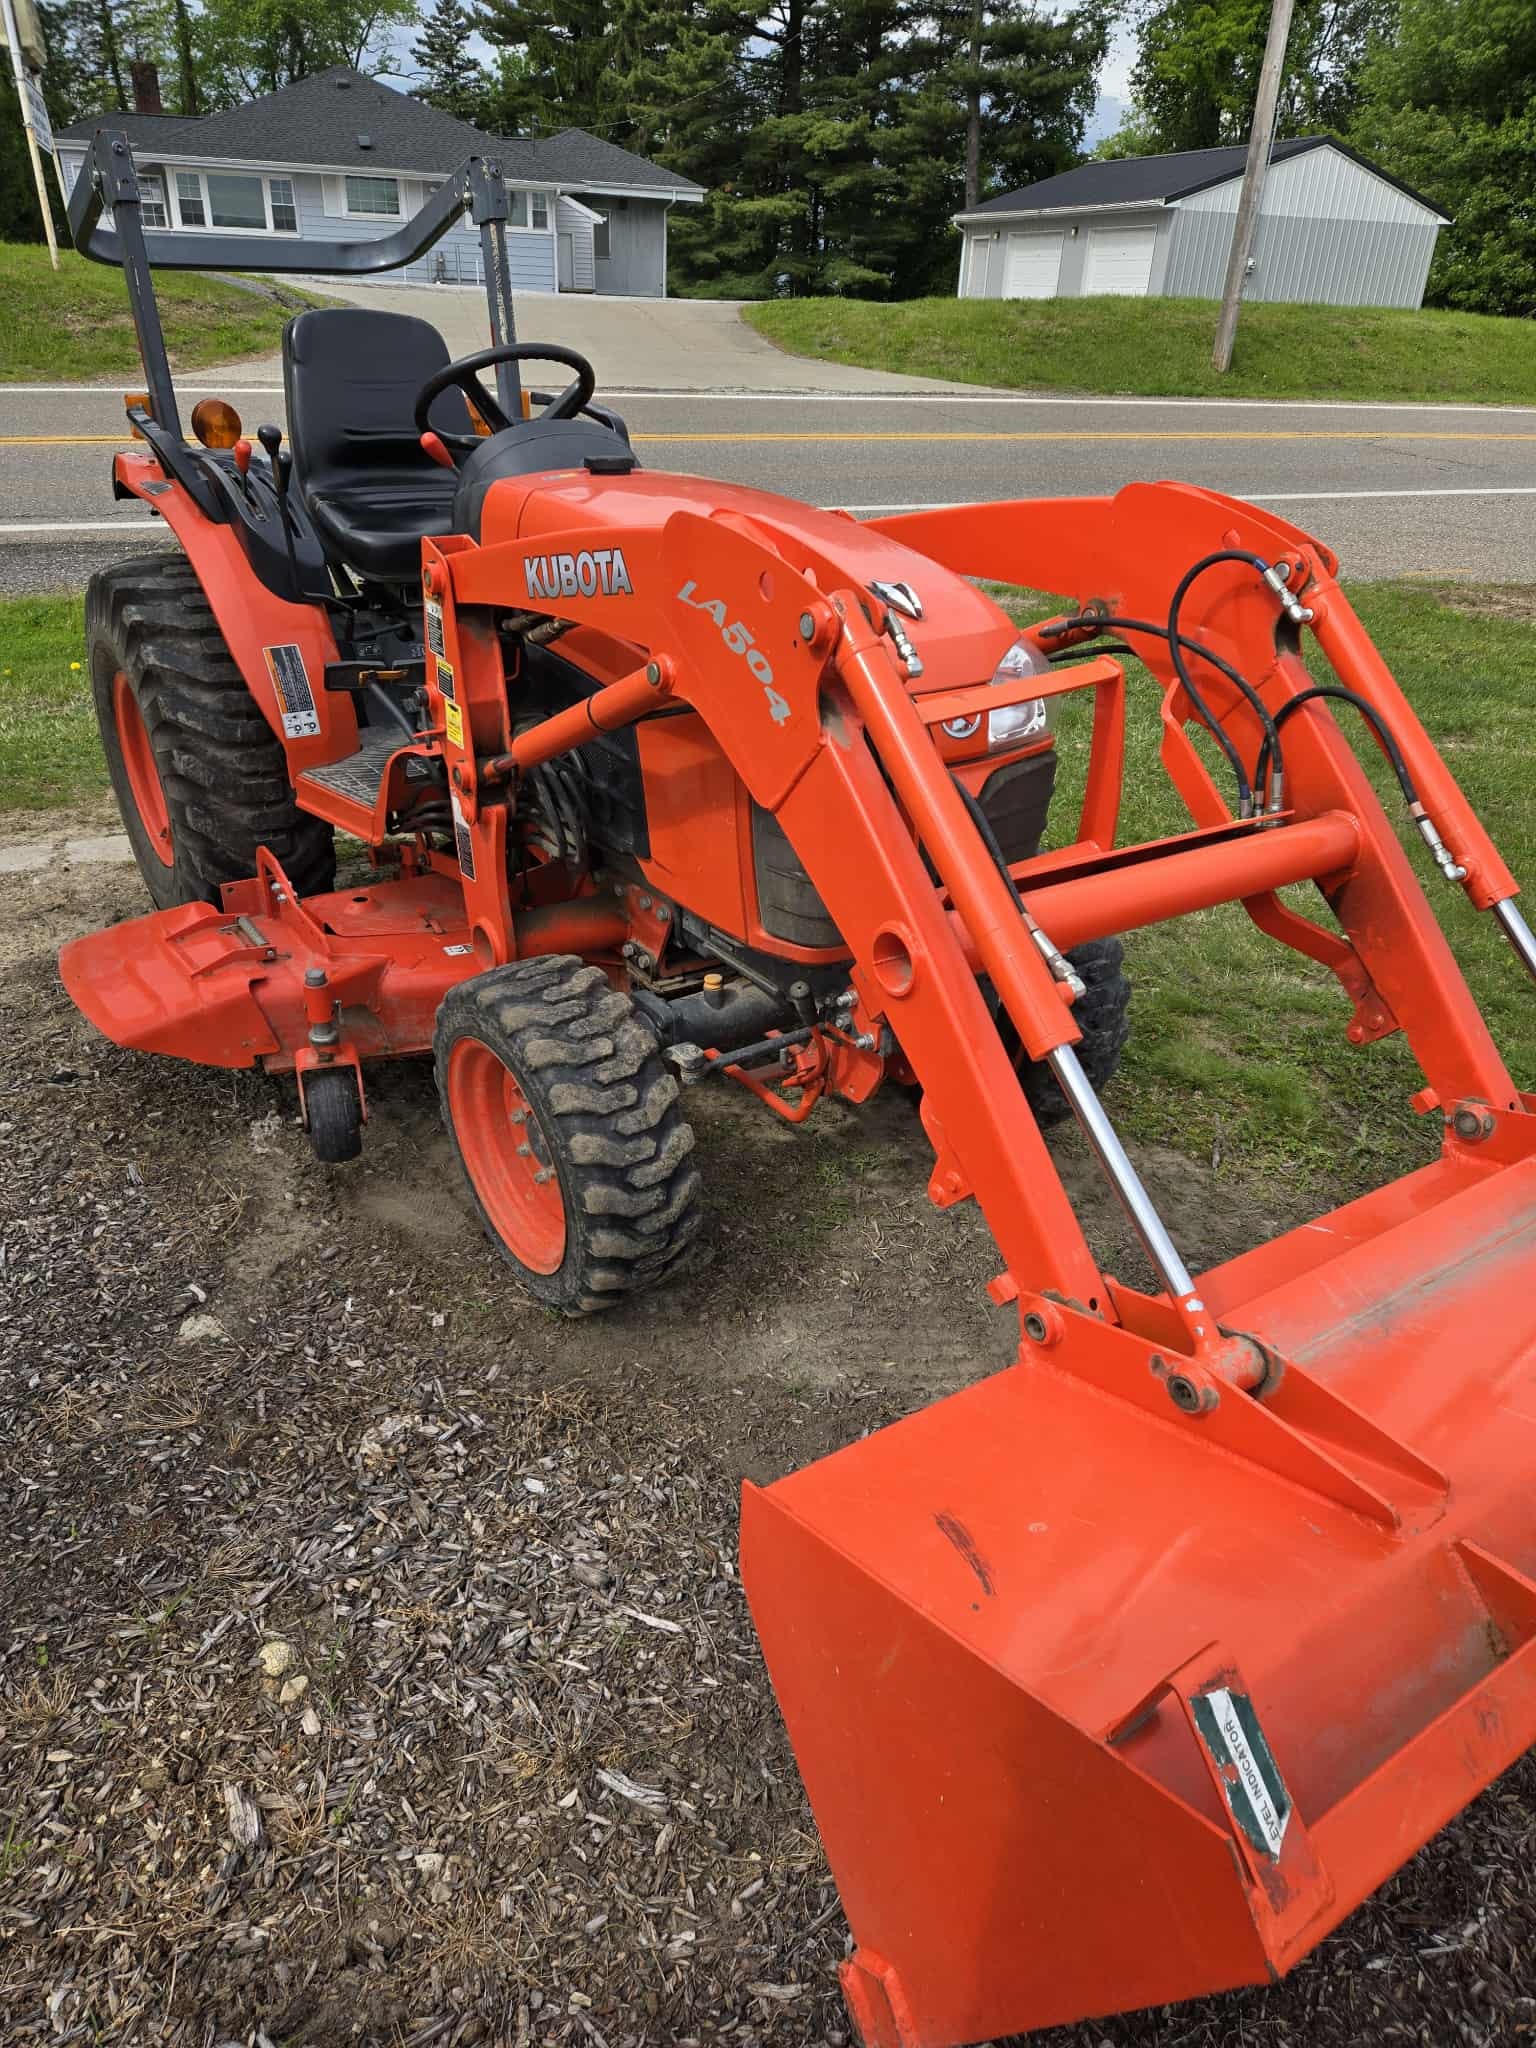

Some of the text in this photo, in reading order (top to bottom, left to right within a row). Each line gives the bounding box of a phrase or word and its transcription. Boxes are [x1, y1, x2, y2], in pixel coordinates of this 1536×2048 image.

[523, 548, 633, 598] KUBOTA
[677, 580, 792, 727] LA504
[1224, 1719, 1282, 1841] EVEL INDICATOR
